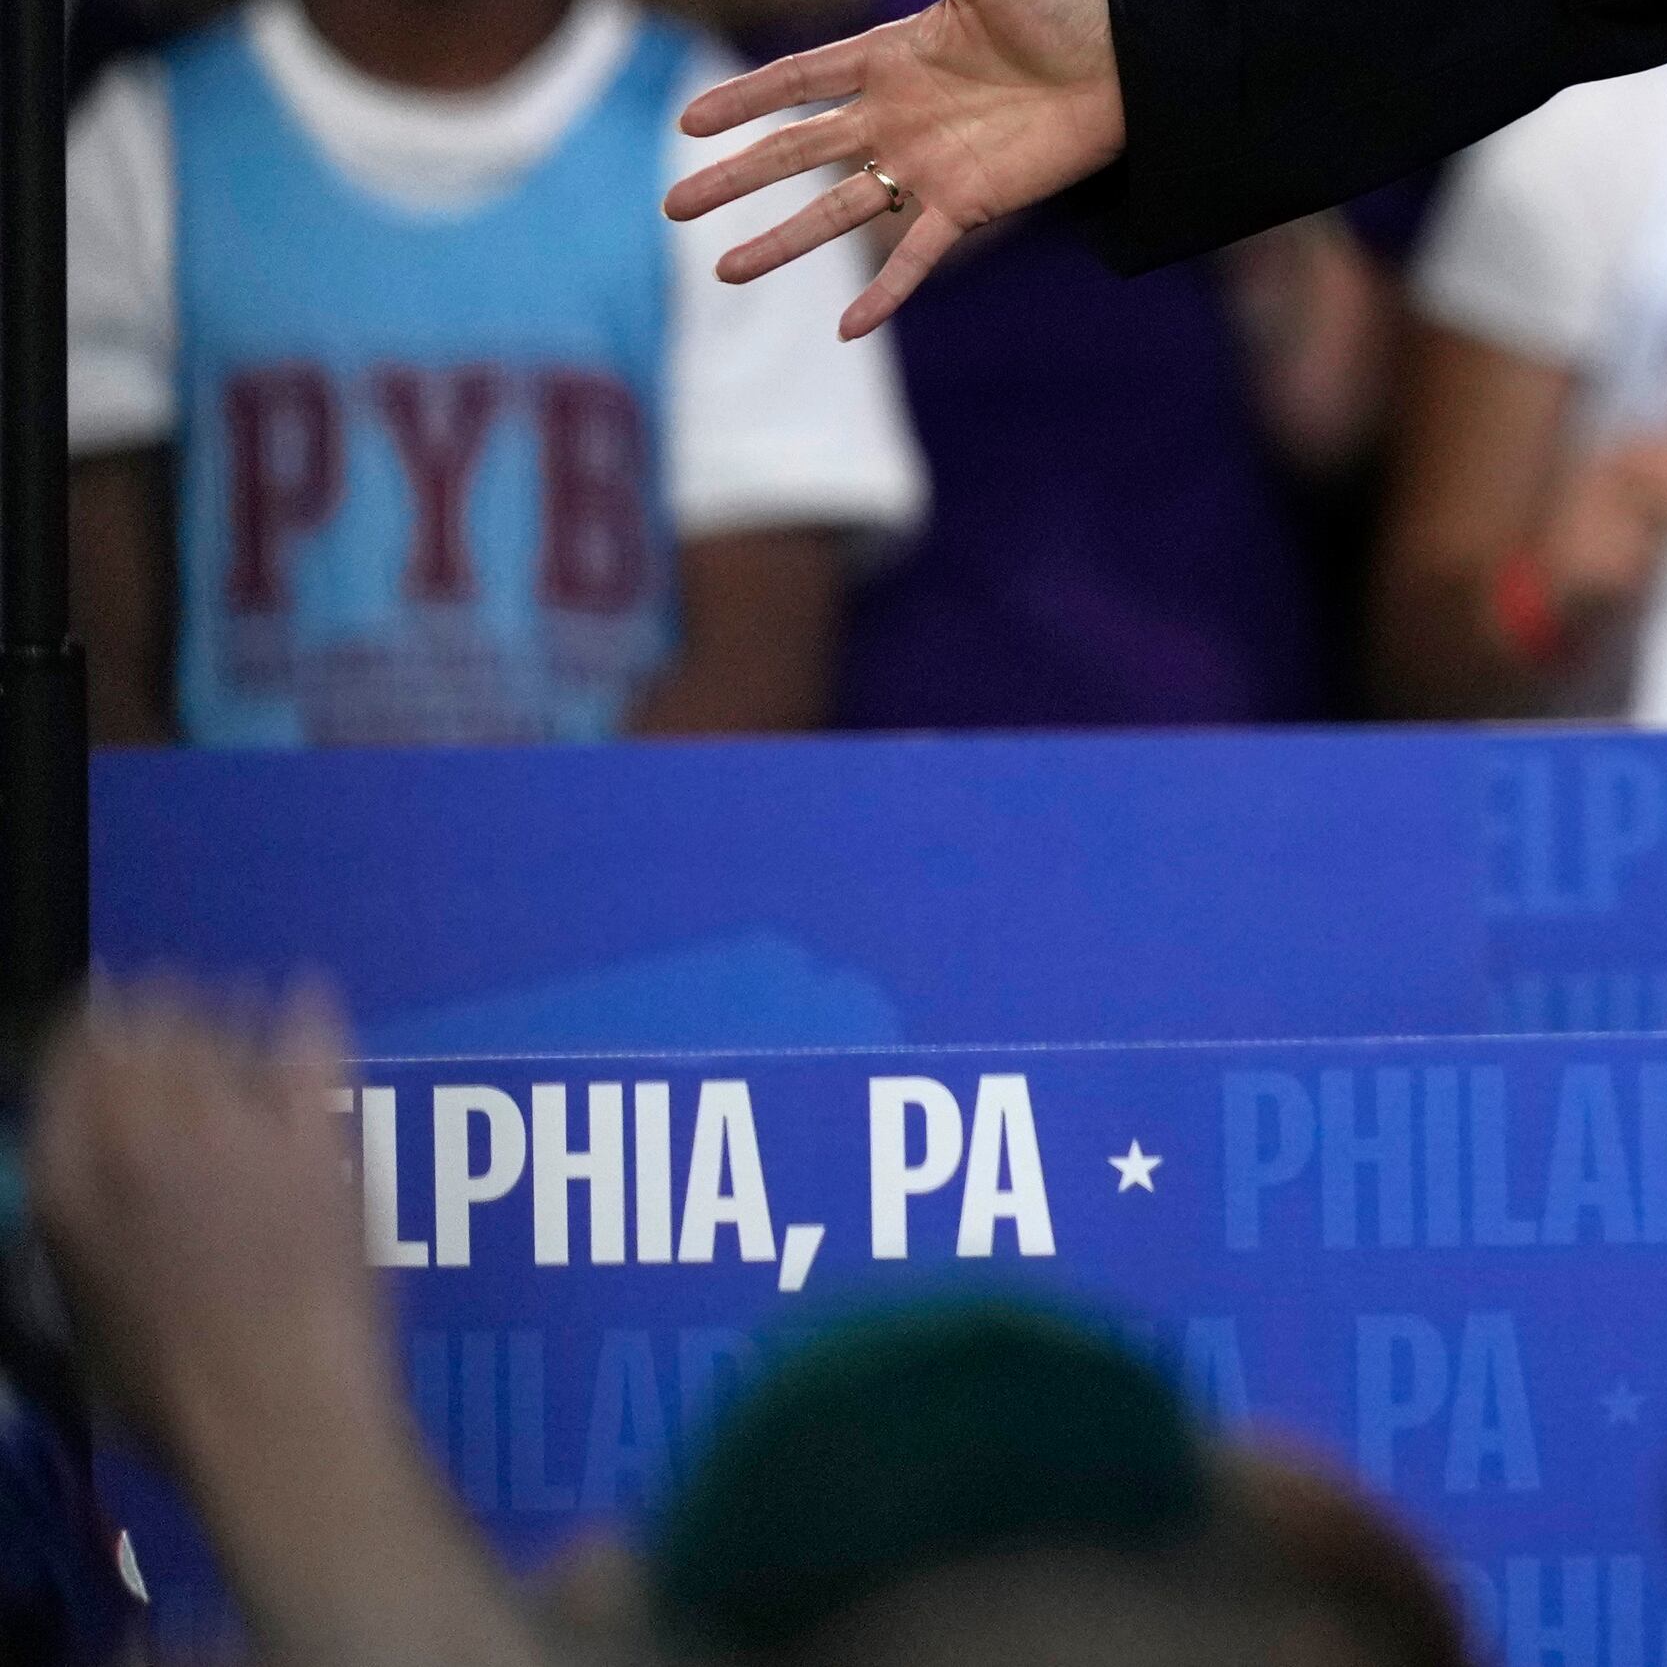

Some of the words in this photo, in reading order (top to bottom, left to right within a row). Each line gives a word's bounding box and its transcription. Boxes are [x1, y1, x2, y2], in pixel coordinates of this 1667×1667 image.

[222, 352, 648, 618] PYB
[867, 1072, 1057, 1262] PA
[1356, 1312, 1541, 1492] PA
